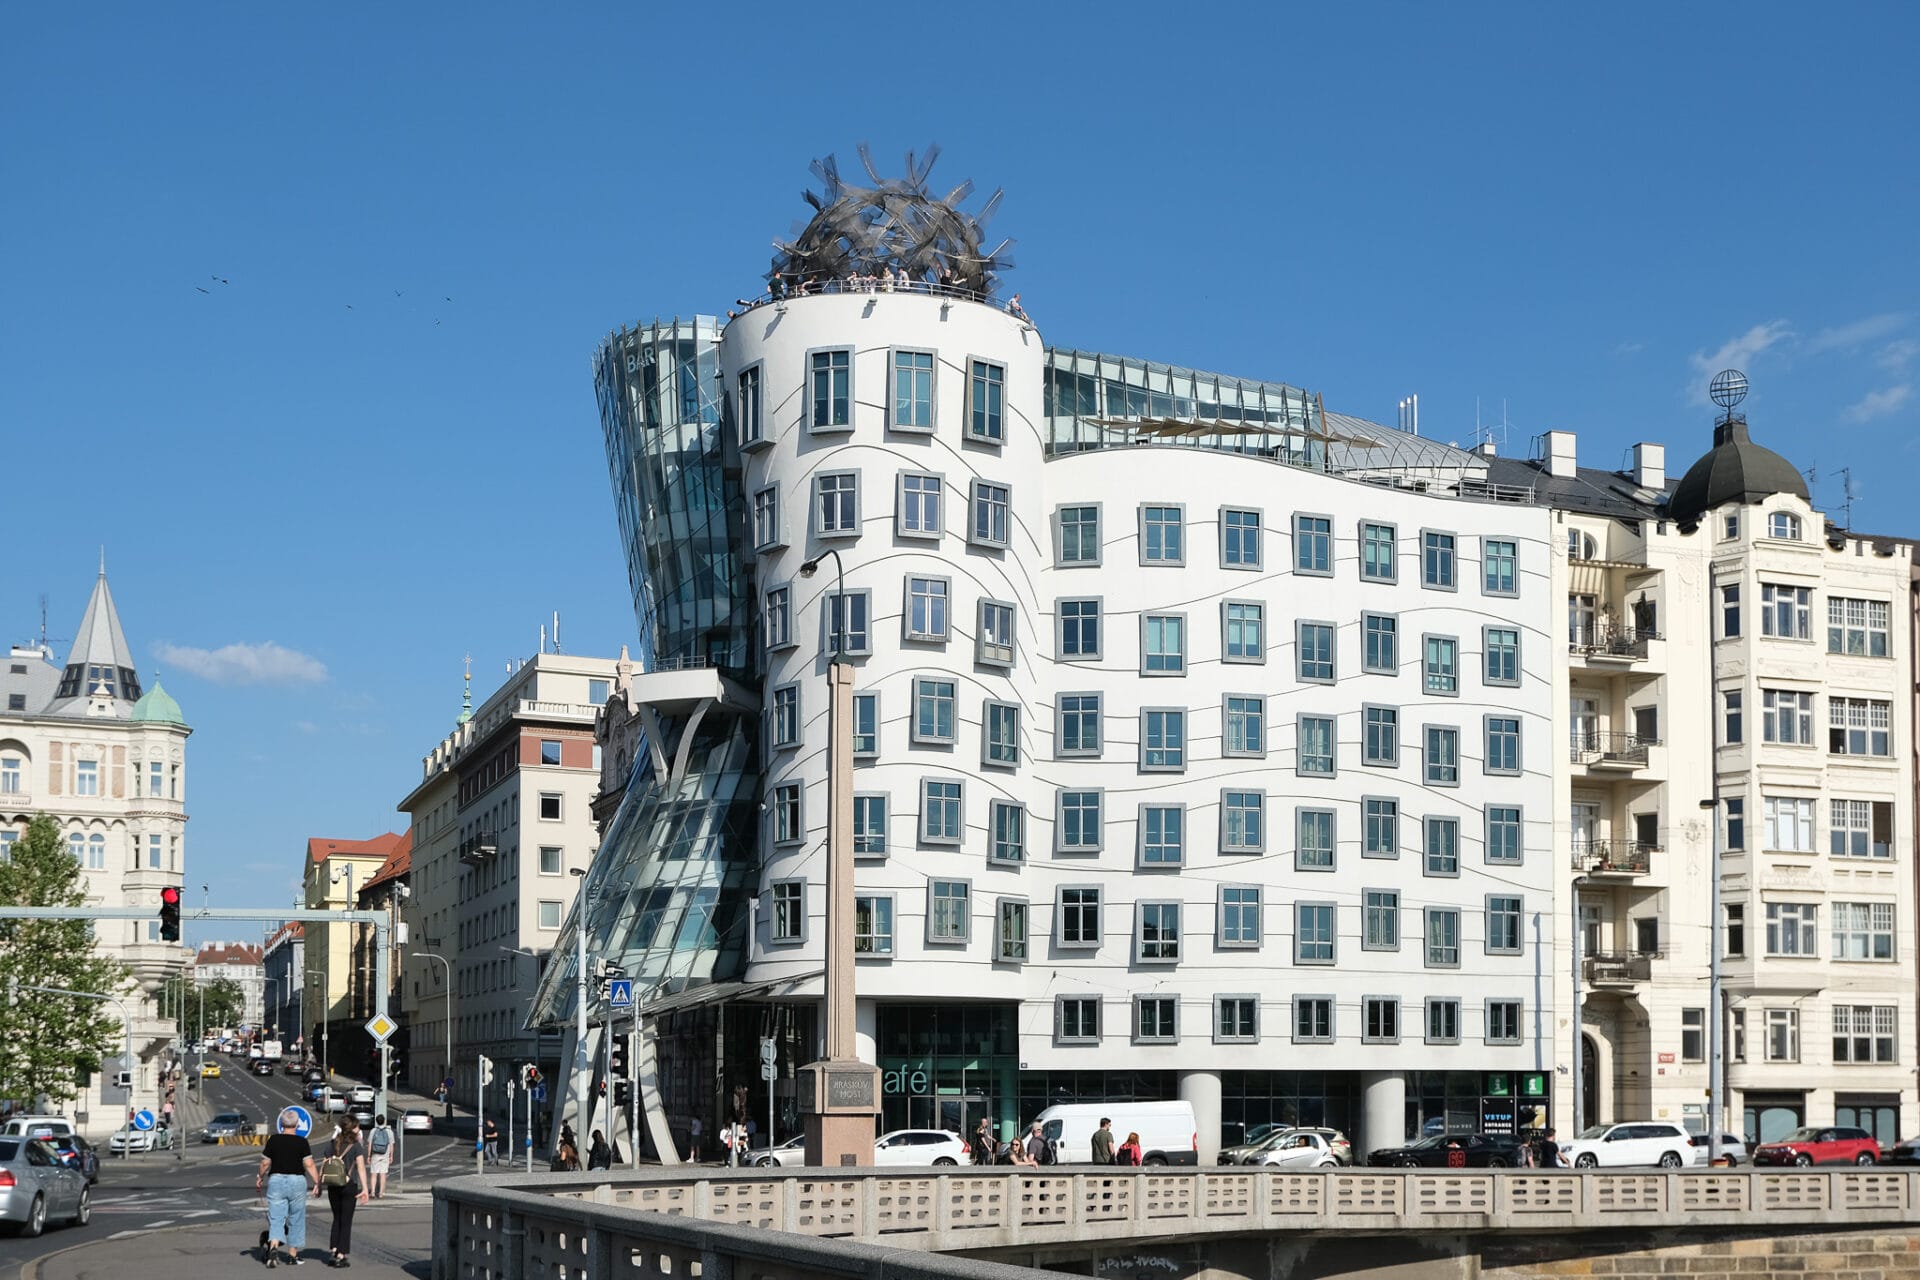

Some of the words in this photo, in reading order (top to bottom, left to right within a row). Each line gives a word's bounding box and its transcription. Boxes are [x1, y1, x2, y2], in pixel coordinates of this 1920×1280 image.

[626, 346, 656, 374] BAR
[883, 1062, 927, 1094] afé
[840, 1090, 861, 1099] MOST
[1484, 1113, 1512, 1121] VSTUP
